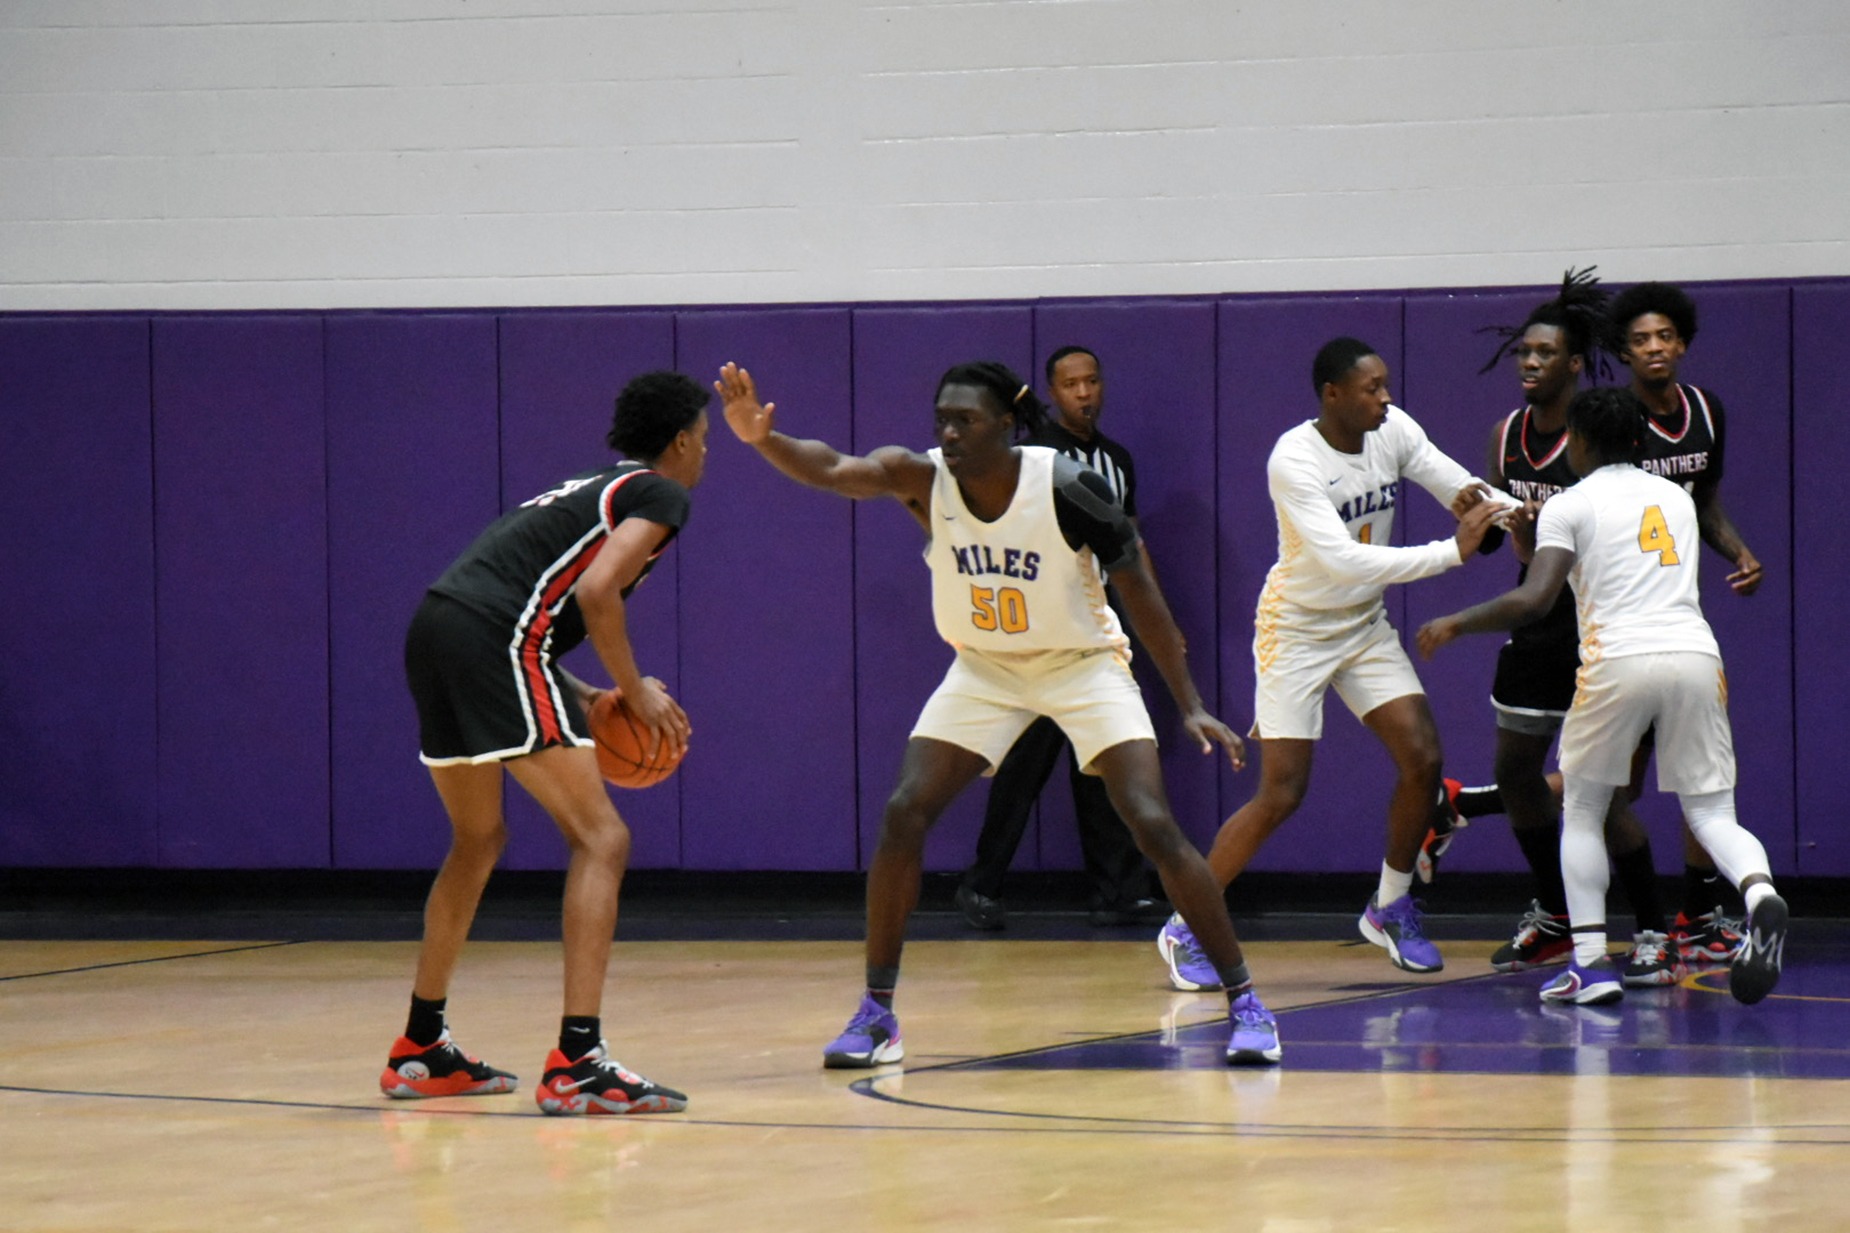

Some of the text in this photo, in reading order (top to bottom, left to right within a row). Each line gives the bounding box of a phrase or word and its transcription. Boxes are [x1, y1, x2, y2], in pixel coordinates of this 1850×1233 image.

[1641, 452, 1709, 476] PANTHERS
[1508, 479, 1566, 502] PANTHE
[1637, 504, 1681, 567] 4
[951, 544, 1041, 582] MILES
[969, 583, 1030, 635] 50
